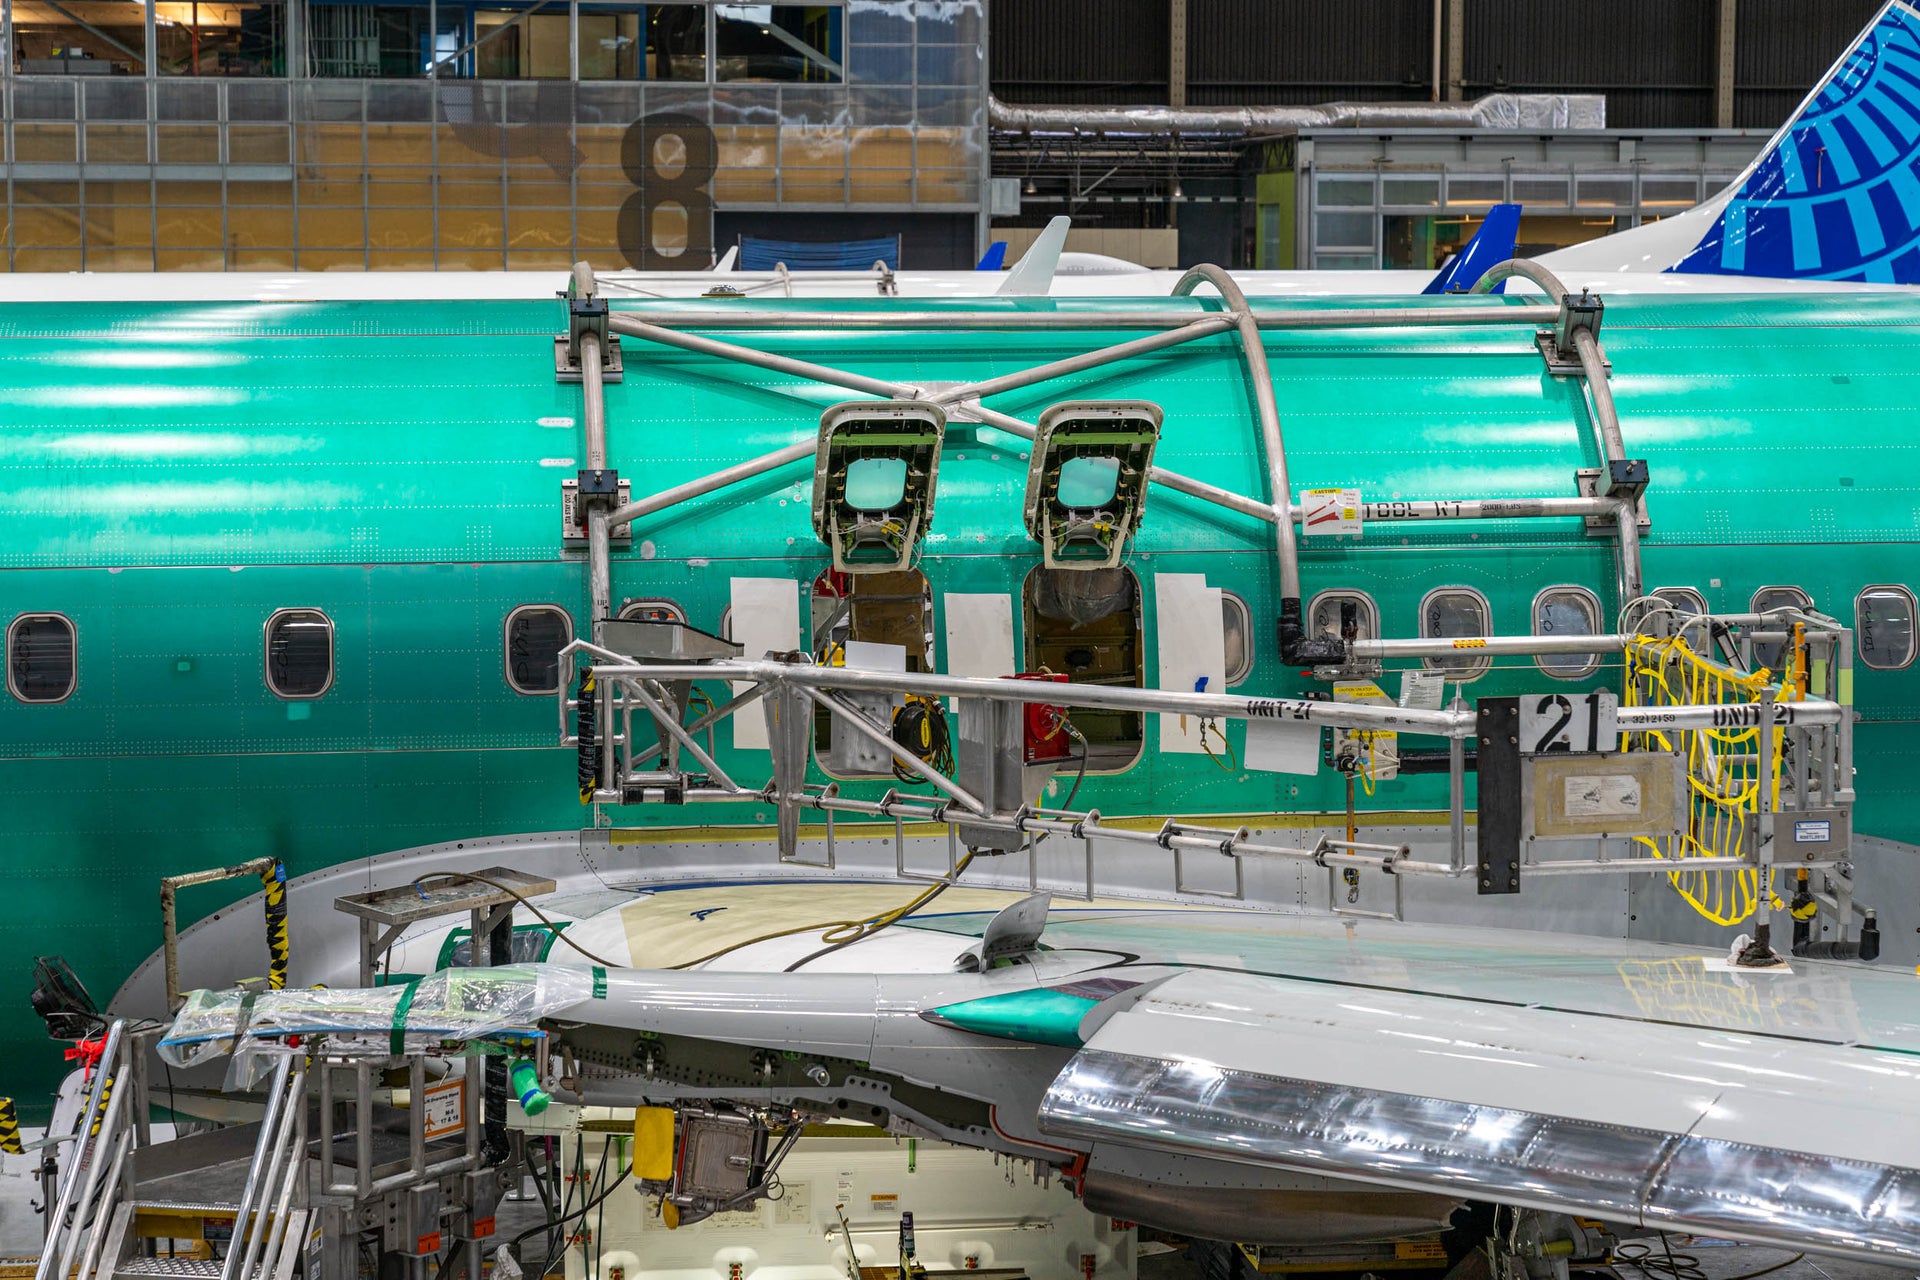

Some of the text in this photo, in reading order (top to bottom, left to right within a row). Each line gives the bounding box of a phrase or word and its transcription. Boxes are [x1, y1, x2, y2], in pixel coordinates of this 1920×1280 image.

[617, 113, 719, 271] 8
[1362, 502, 1420, 518] TOOL
[1534, 694, 1600, 754] 21
[1632, 714, 1676, 724] 3212159
[1713, 705, 1760, 726] UNIT
